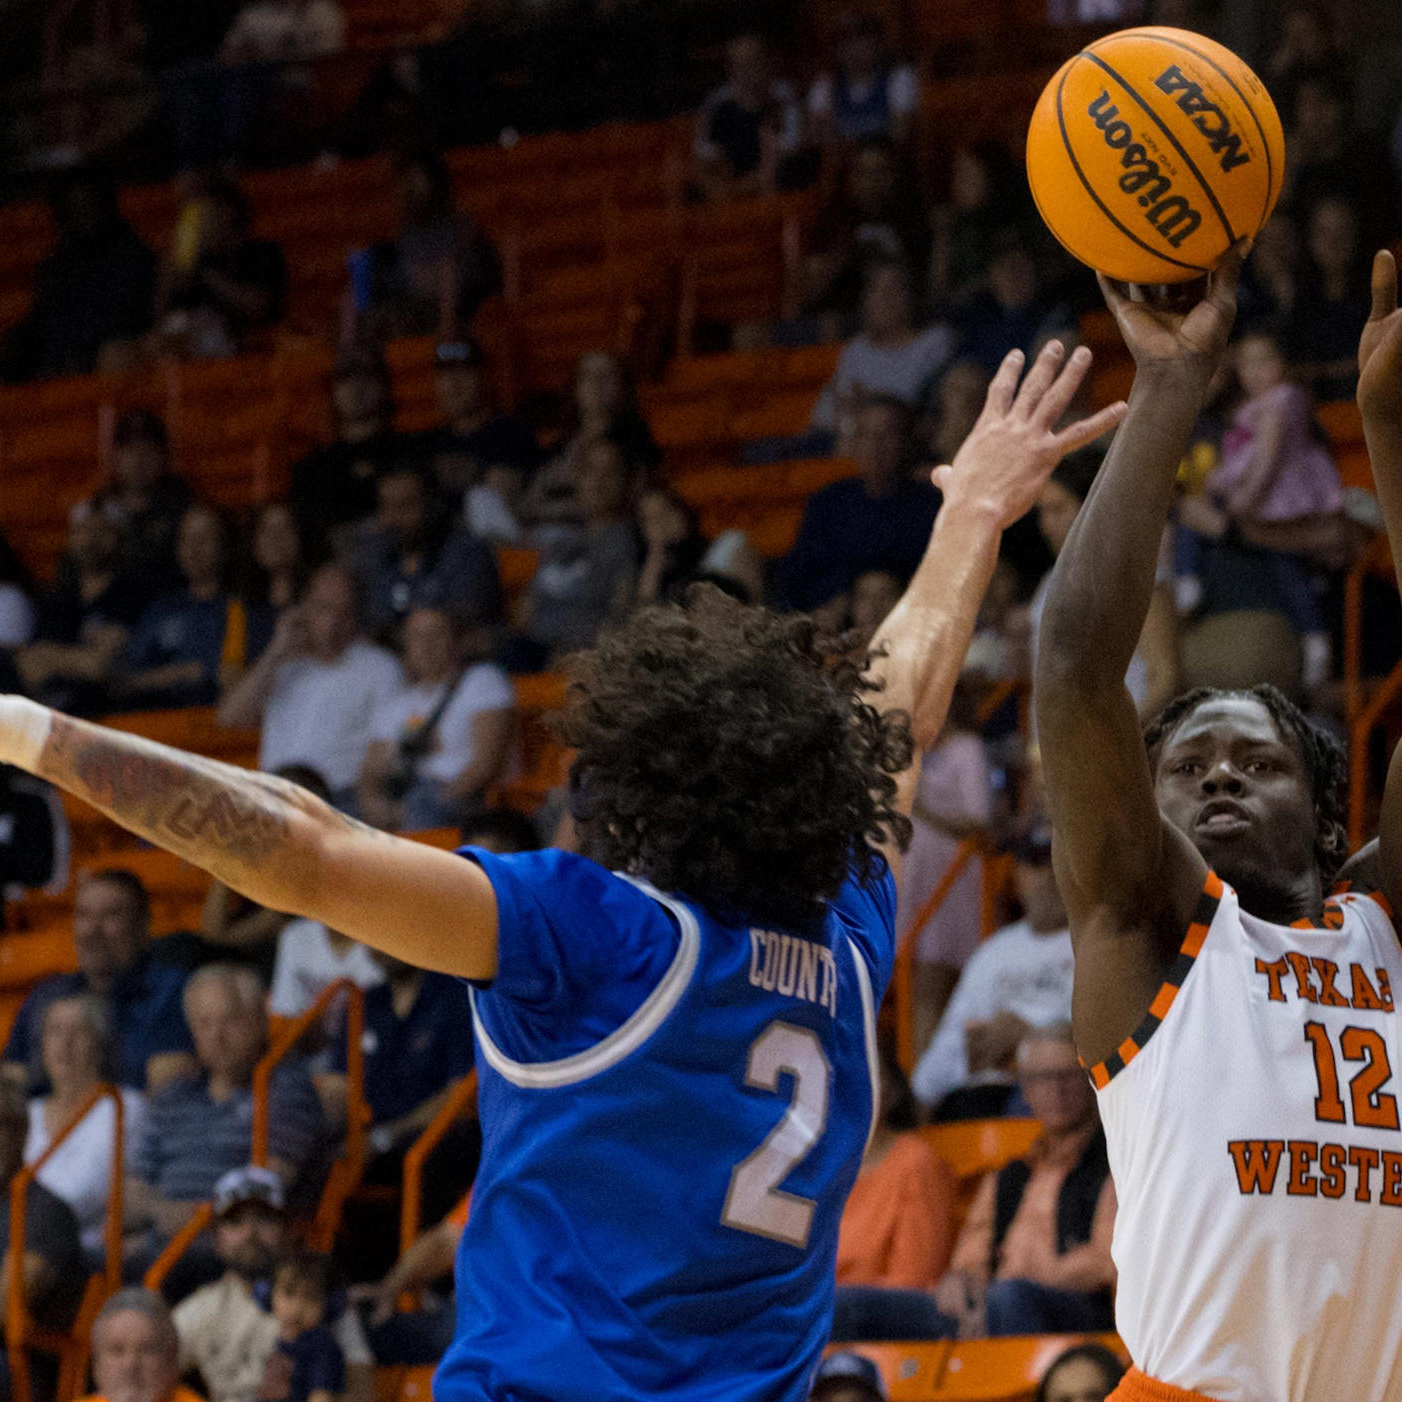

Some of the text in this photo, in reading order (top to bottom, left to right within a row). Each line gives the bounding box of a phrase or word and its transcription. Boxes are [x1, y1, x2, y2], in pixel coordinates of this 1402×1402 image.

[1087, 89, 1202, 249] Wilson
[1154, 64, 1251, 173] NCAA
[720, 1019, 833, 1249] 2
[1304, 1019, 1401, 1132] 12
